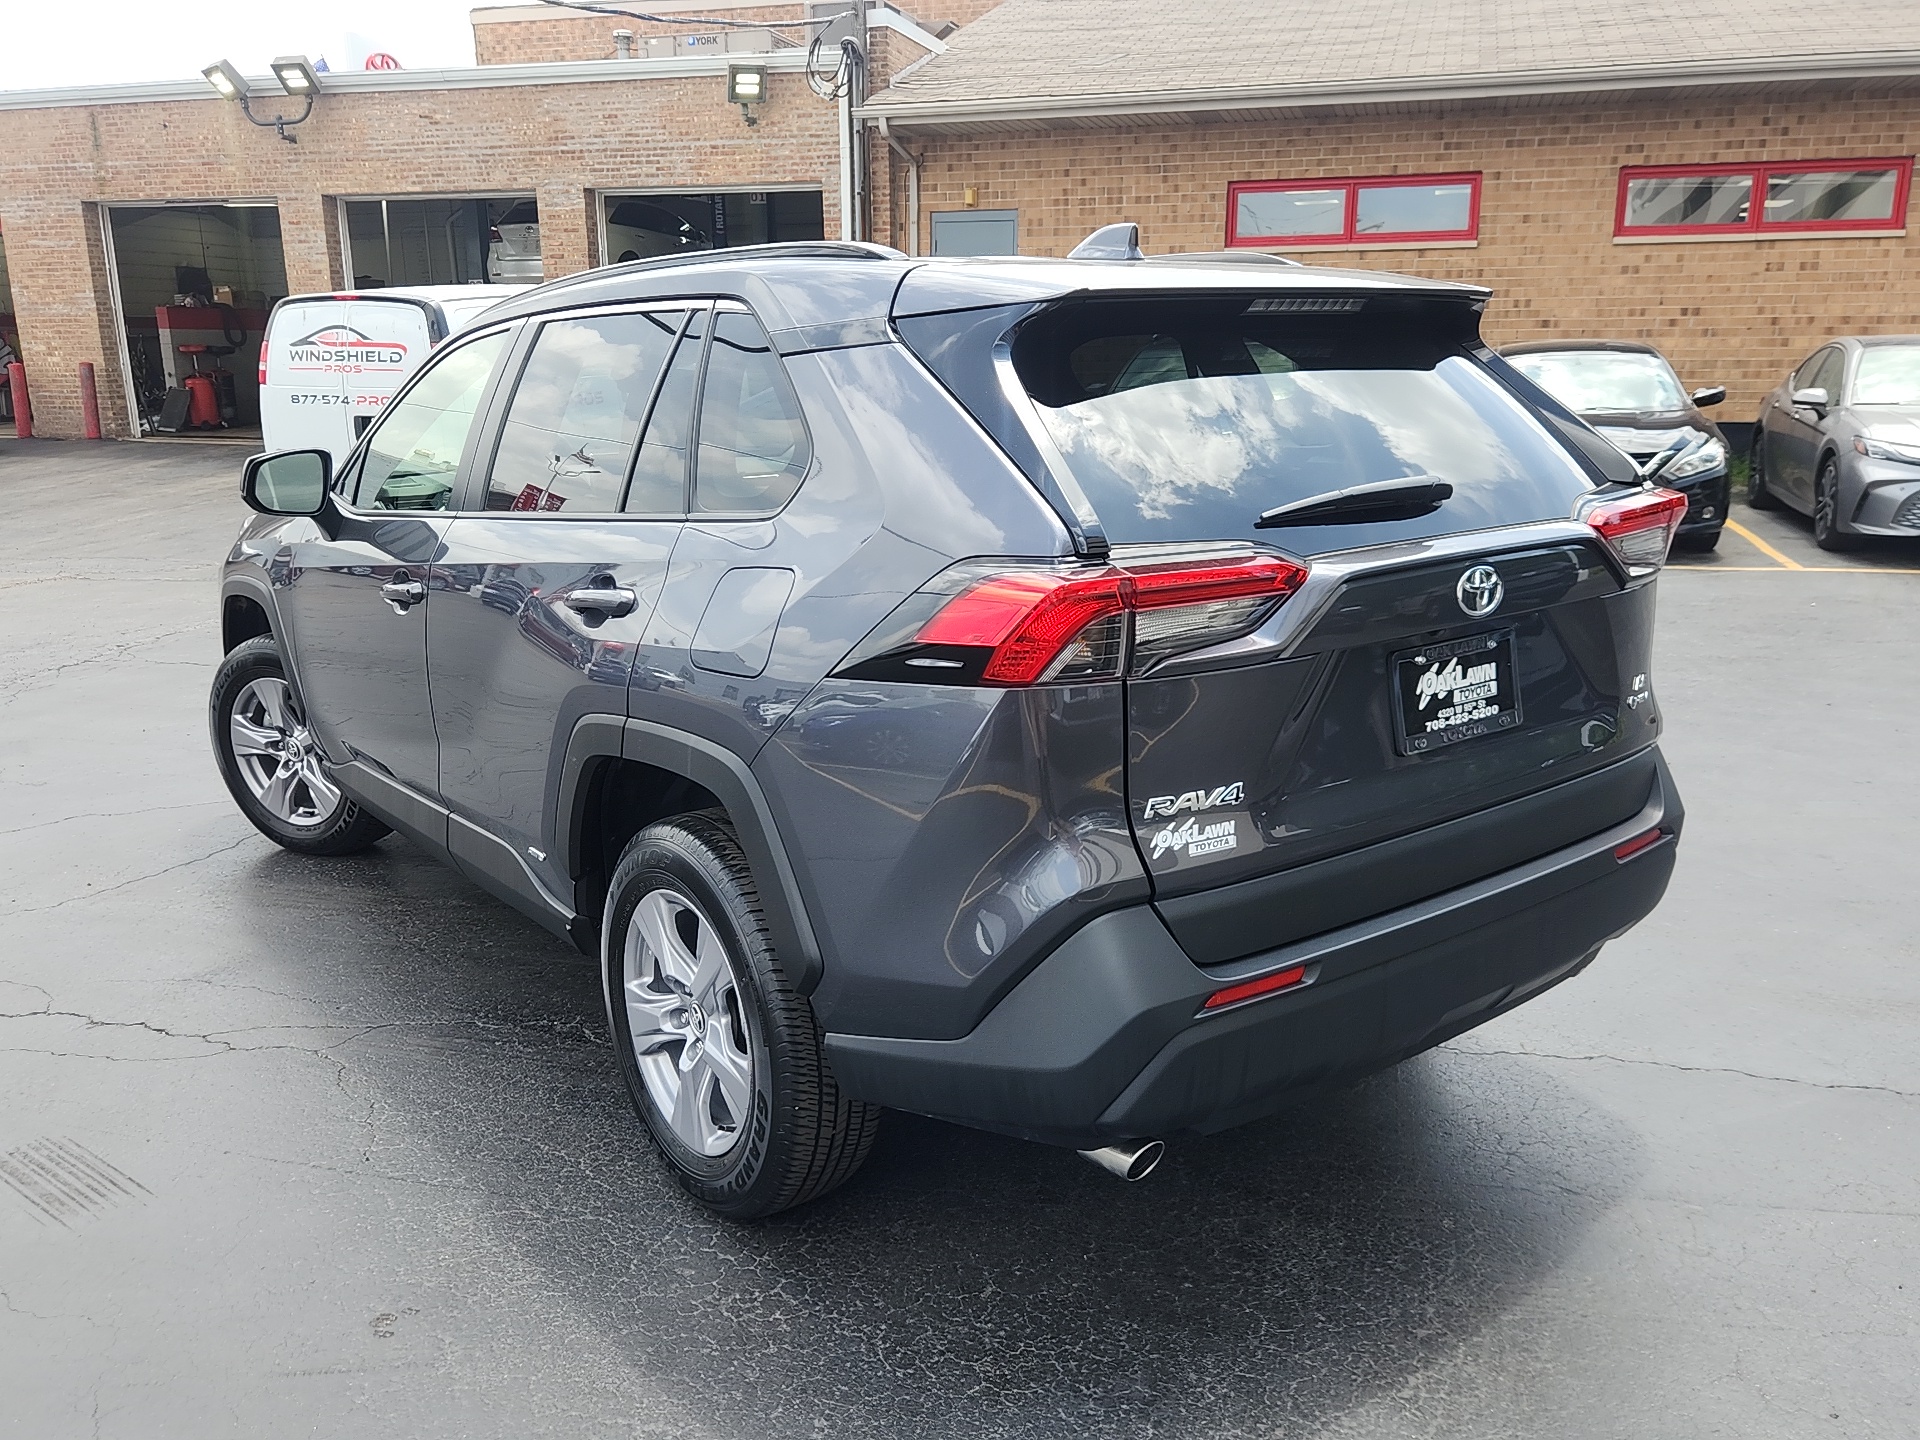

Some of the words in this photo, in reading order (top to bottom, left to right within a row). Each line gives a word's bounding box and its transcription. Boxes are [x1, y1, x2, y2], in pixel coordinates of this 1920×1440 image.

[695, 36, 718, 45] YORK
[289, 350, 403, 363] WINDSHIELD
[324, 365, 362, 373] PROS
[1459, 684, 1493, 700] TOYOTA
[1455, 703, 1463, 713] W
[1424, 705, 1500, 733] 708-423-5200
[1143, 781, 1245, 819] RAV4
[1194, 837, 1230, 852] TOYOTA
